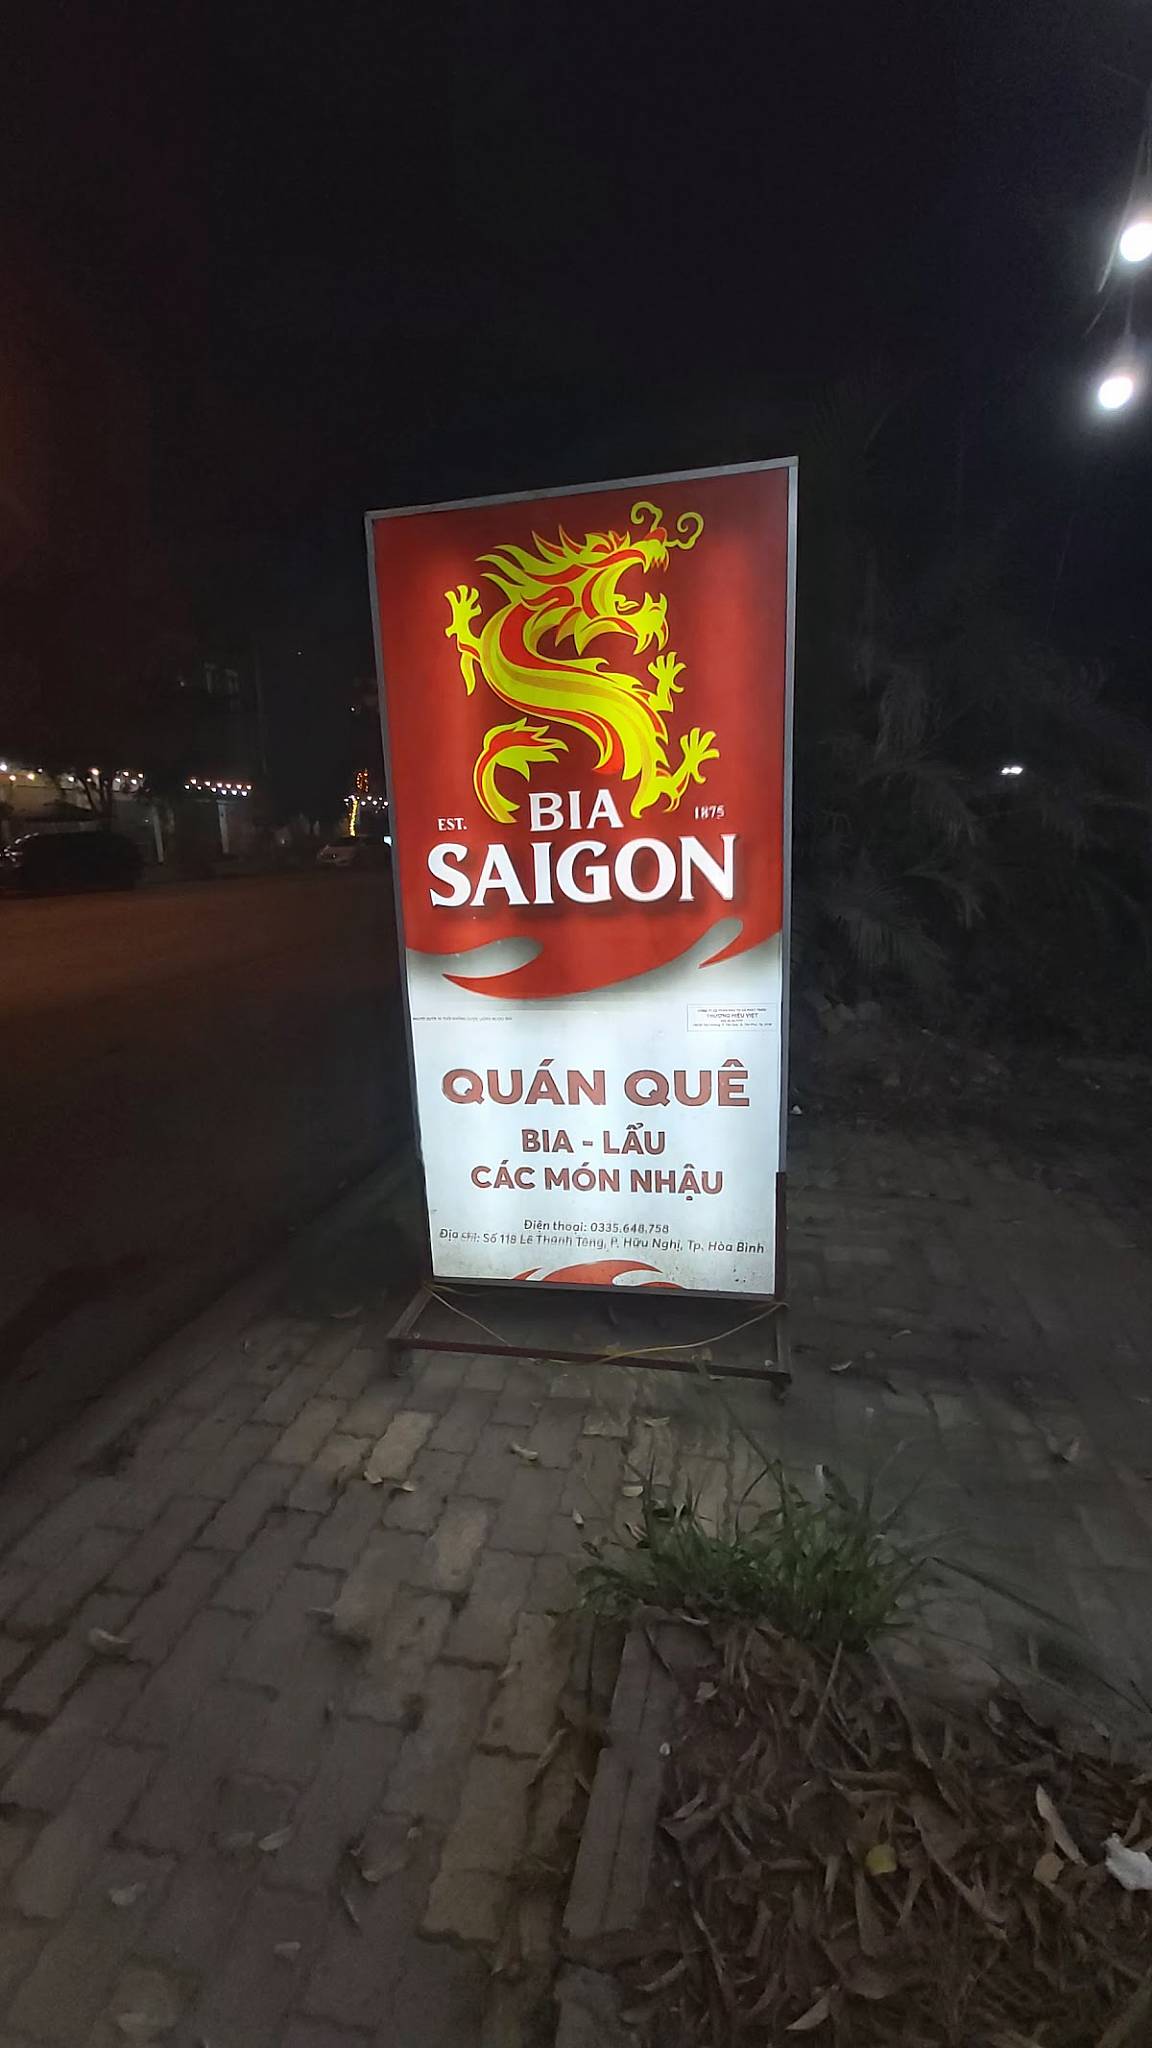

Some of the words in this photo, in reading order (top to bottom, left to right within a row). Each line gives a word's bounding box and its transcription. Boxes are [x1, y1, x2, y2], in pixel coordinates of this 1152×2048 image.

[437, 817, 468, 831] EST.
[529, 789, 625, 832] BIA
[694, 804, 726, 820] 1875
[427, 834, 737, 907] SAIGON
[442, 1058, 607, 1106] QUÁN
[624, 1058, 750, 1107] QUÊ
[521, 1129, 574, 1153] BIA
[603, 1122, 666, 1155] LẨU
[471, 1159, 536, 1190] CÁC
[544, 1161, 620, 1192] MÓN
[630, 1163, 723, 1201] NHẬU
[439, 1228, 459, 1242] Địa
[483, 1232, 498, 1243] Số
[500, 1234, 517, 1244] 118
[519, 1234, 534, 1245] Lê
[610, 1236, 620, 1248] P.
[623, 1238, 649, 1248] Hữu
[651, 1238, 683, 1252] Nghị,
[687, 1240, 704, 1253] Tp.
[708, 1241, 734, 1252] Hòa
[736, 1242, 765, 1254] Bình
[523, 1219, 550, 1233] Điện
[552, 1220, 587, 1235] thoại:
[590, 1222, 669, 1234] 0335.648.758
